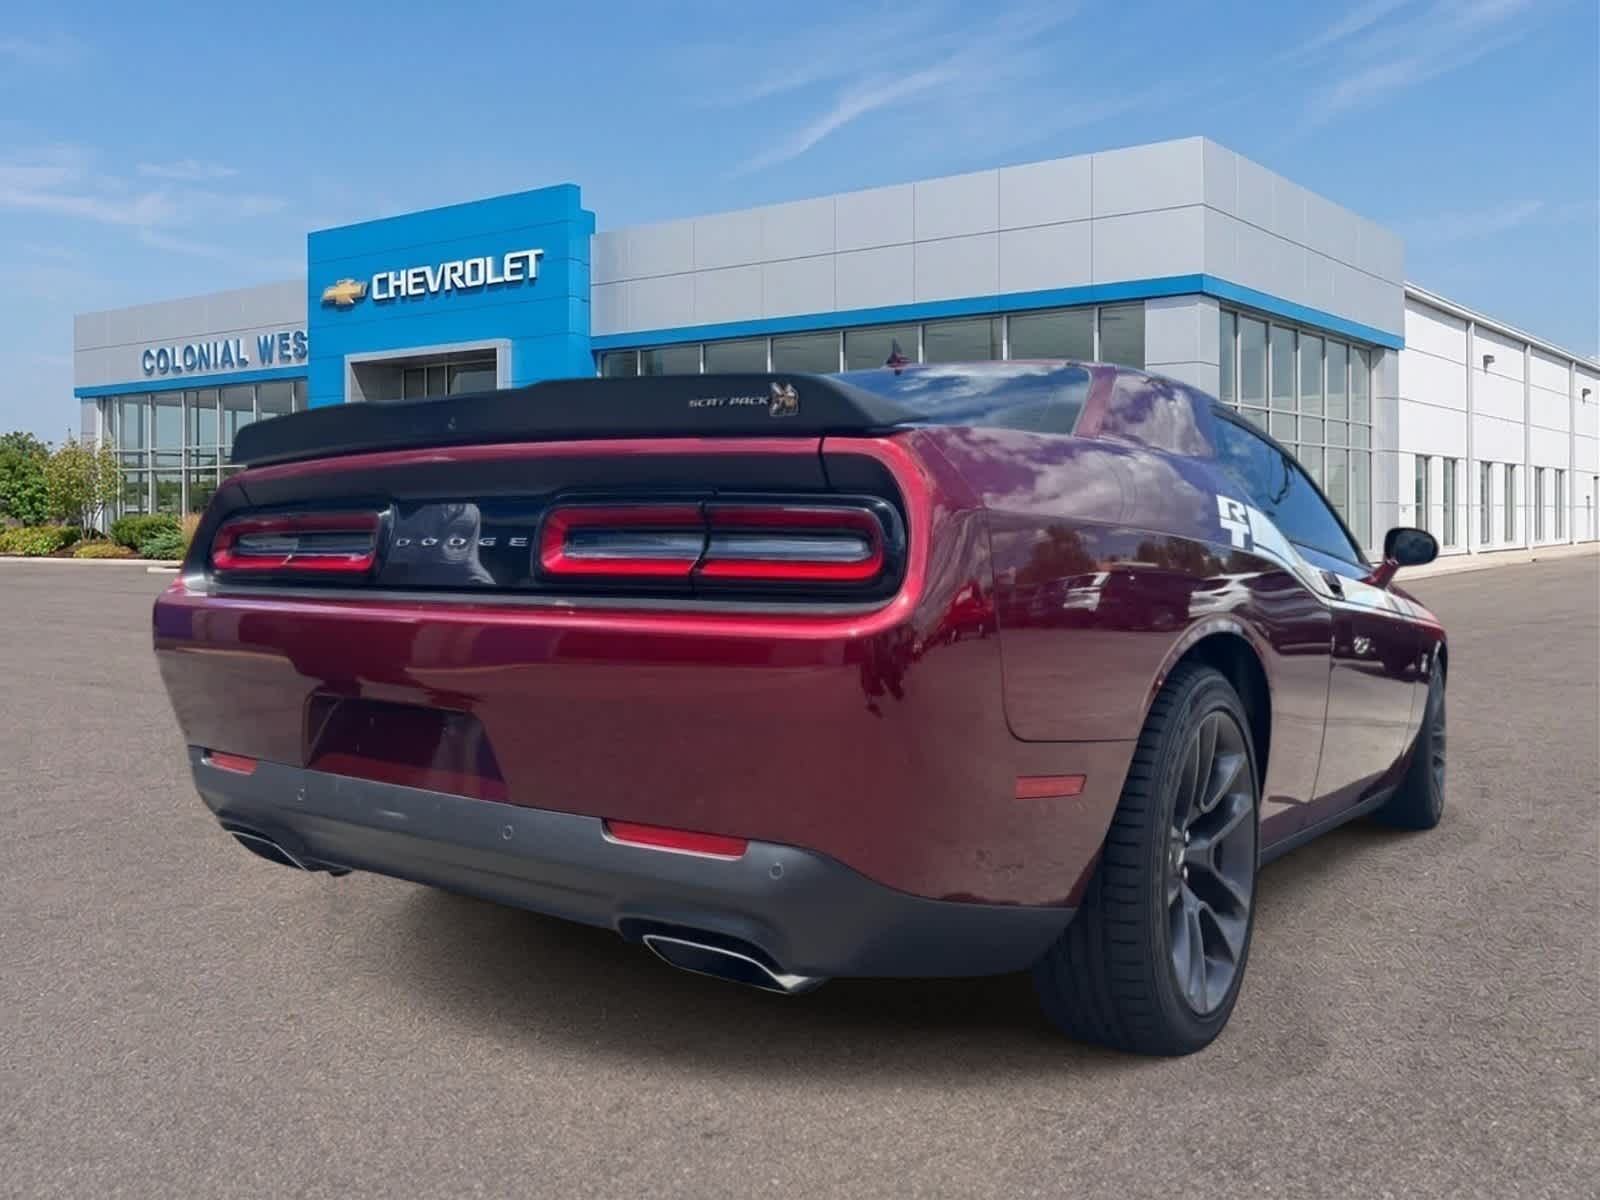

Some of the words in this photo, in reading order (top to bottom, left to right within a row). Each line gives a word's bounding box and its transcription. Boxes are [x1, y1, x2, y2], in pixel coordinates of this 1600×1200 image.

[372, 248, 545, 300] CHEVROLET
[142, 338, 249, 376] COLONIAL
[395, 536, 529, 548] DODGE
